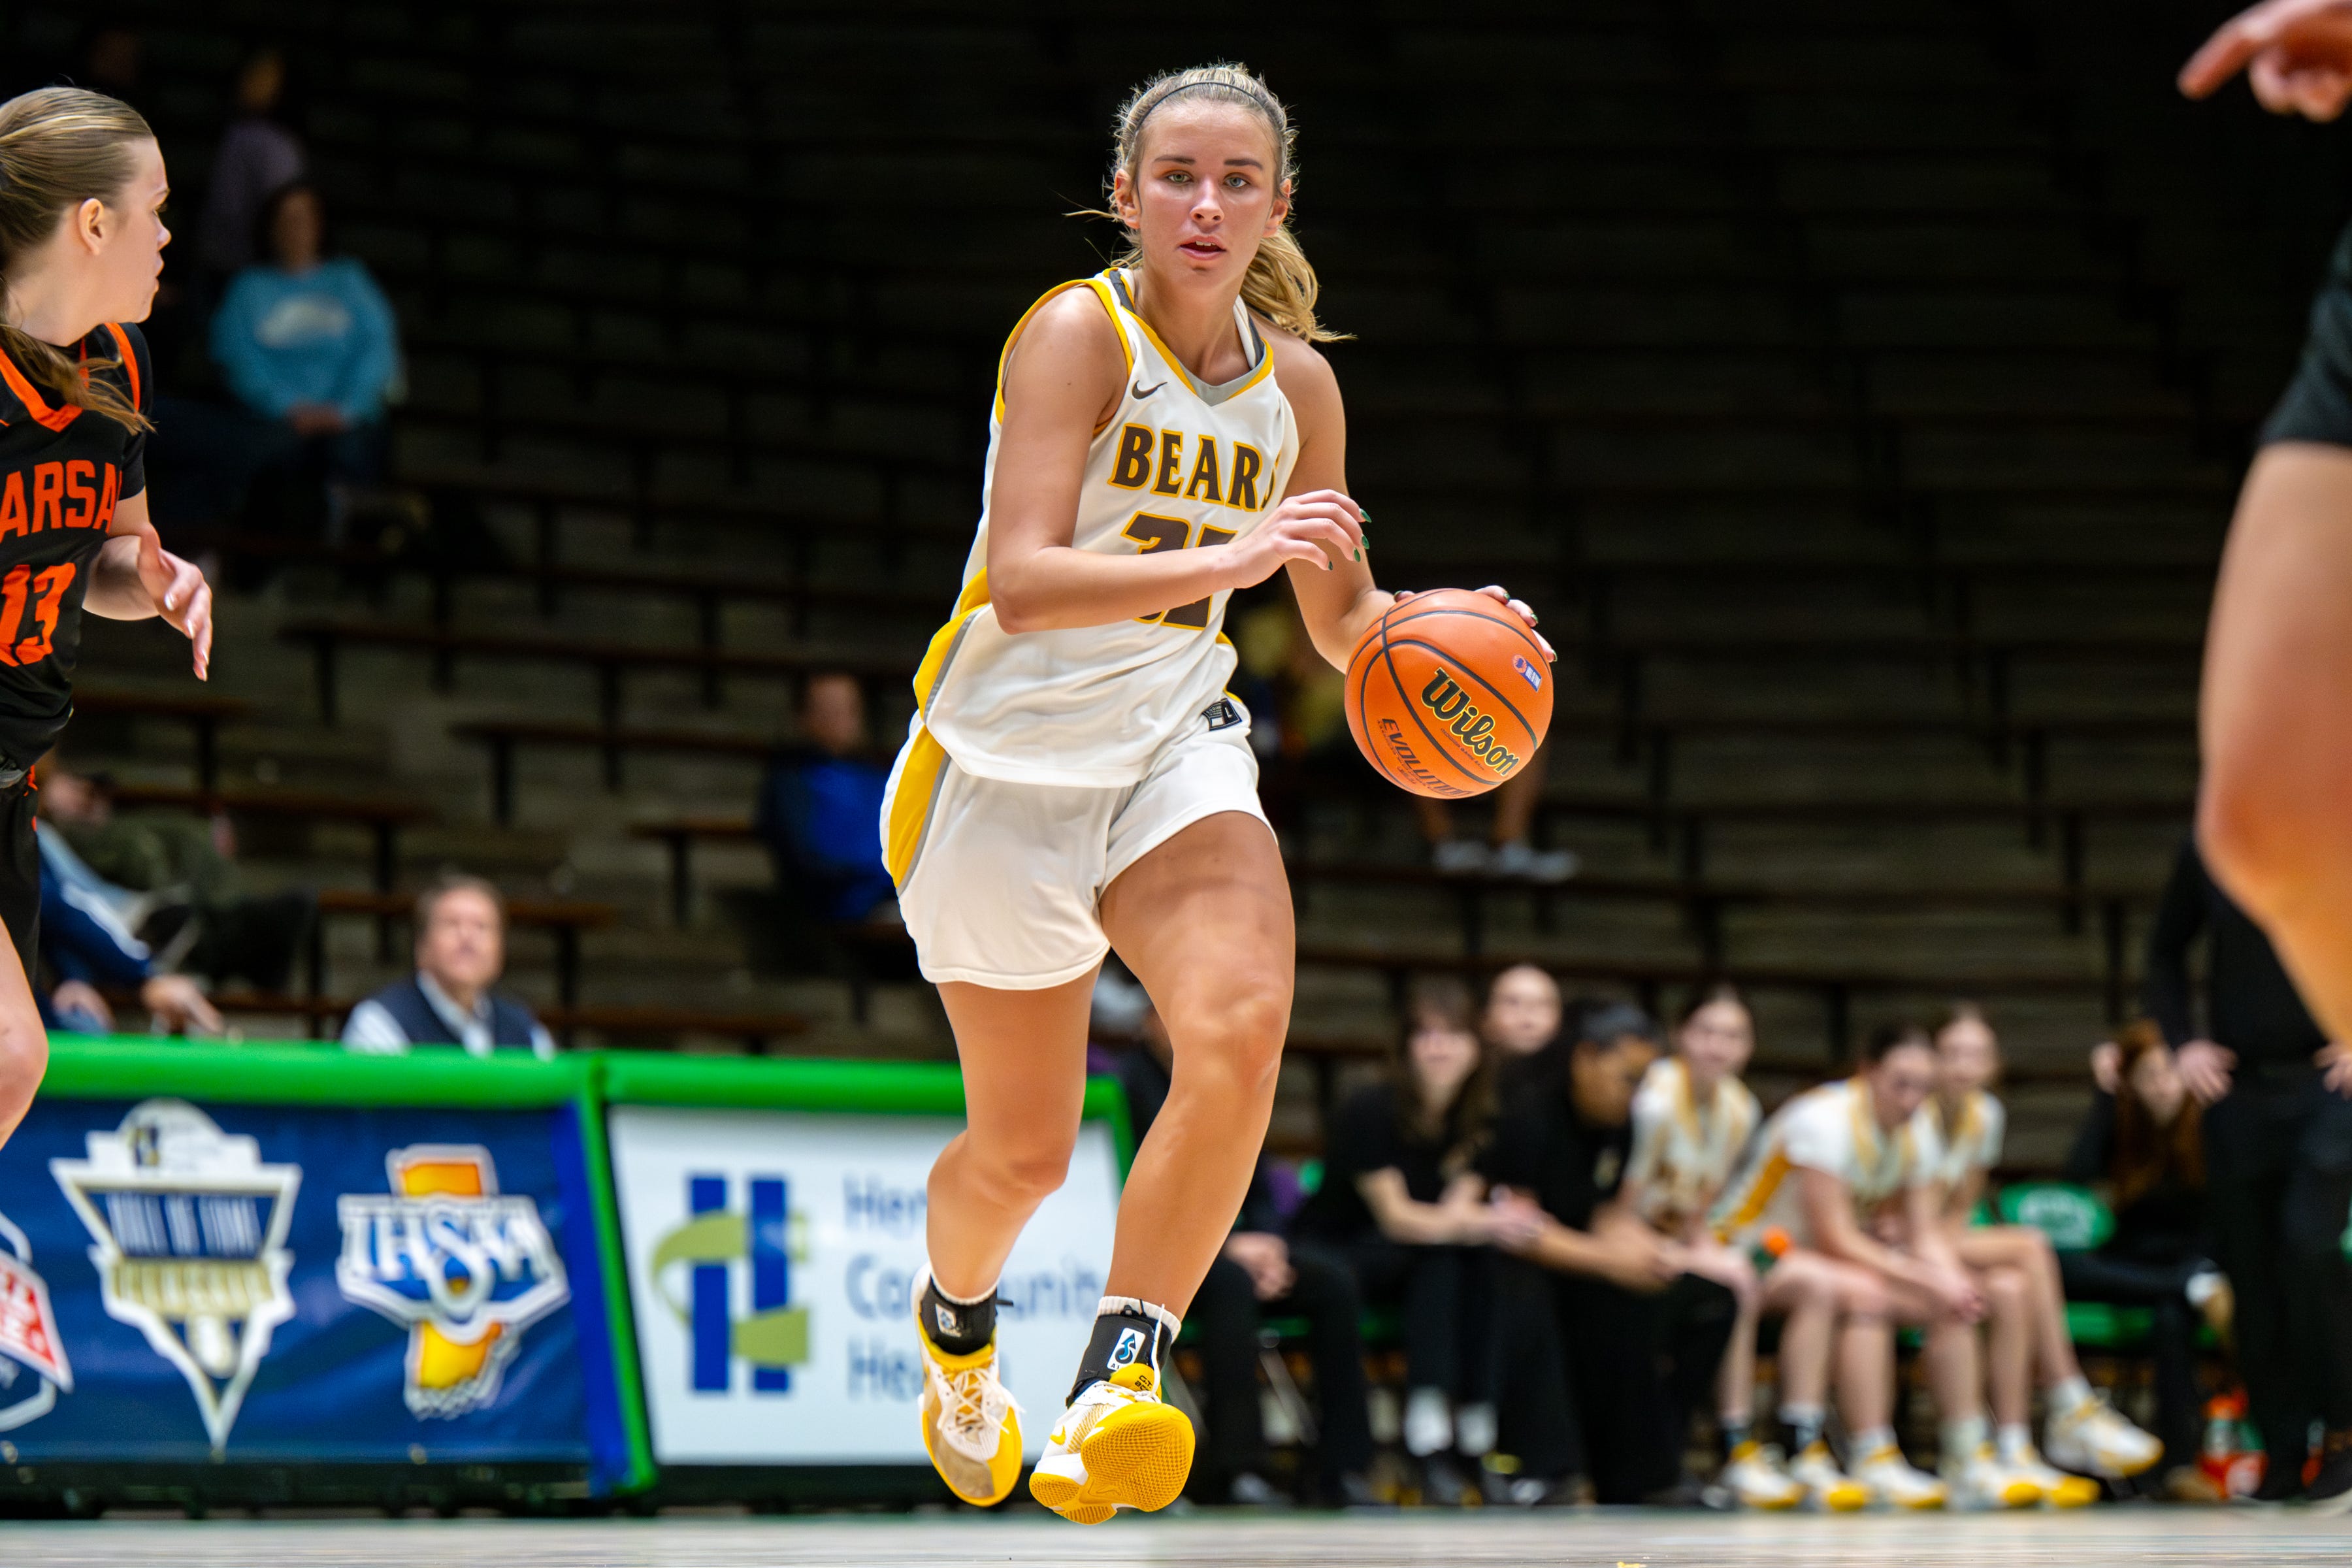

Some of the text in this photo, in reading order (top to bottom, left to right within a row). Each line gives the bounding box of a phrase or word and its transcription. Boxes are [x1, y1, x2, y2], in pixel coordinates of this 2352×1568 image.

[0, 459, 122, 543] ARSA
[1107, 423, 1281, 512] BEAR
[0, 562, 76, 667] 13
[1420, 667, 1520, 777] Wilson
